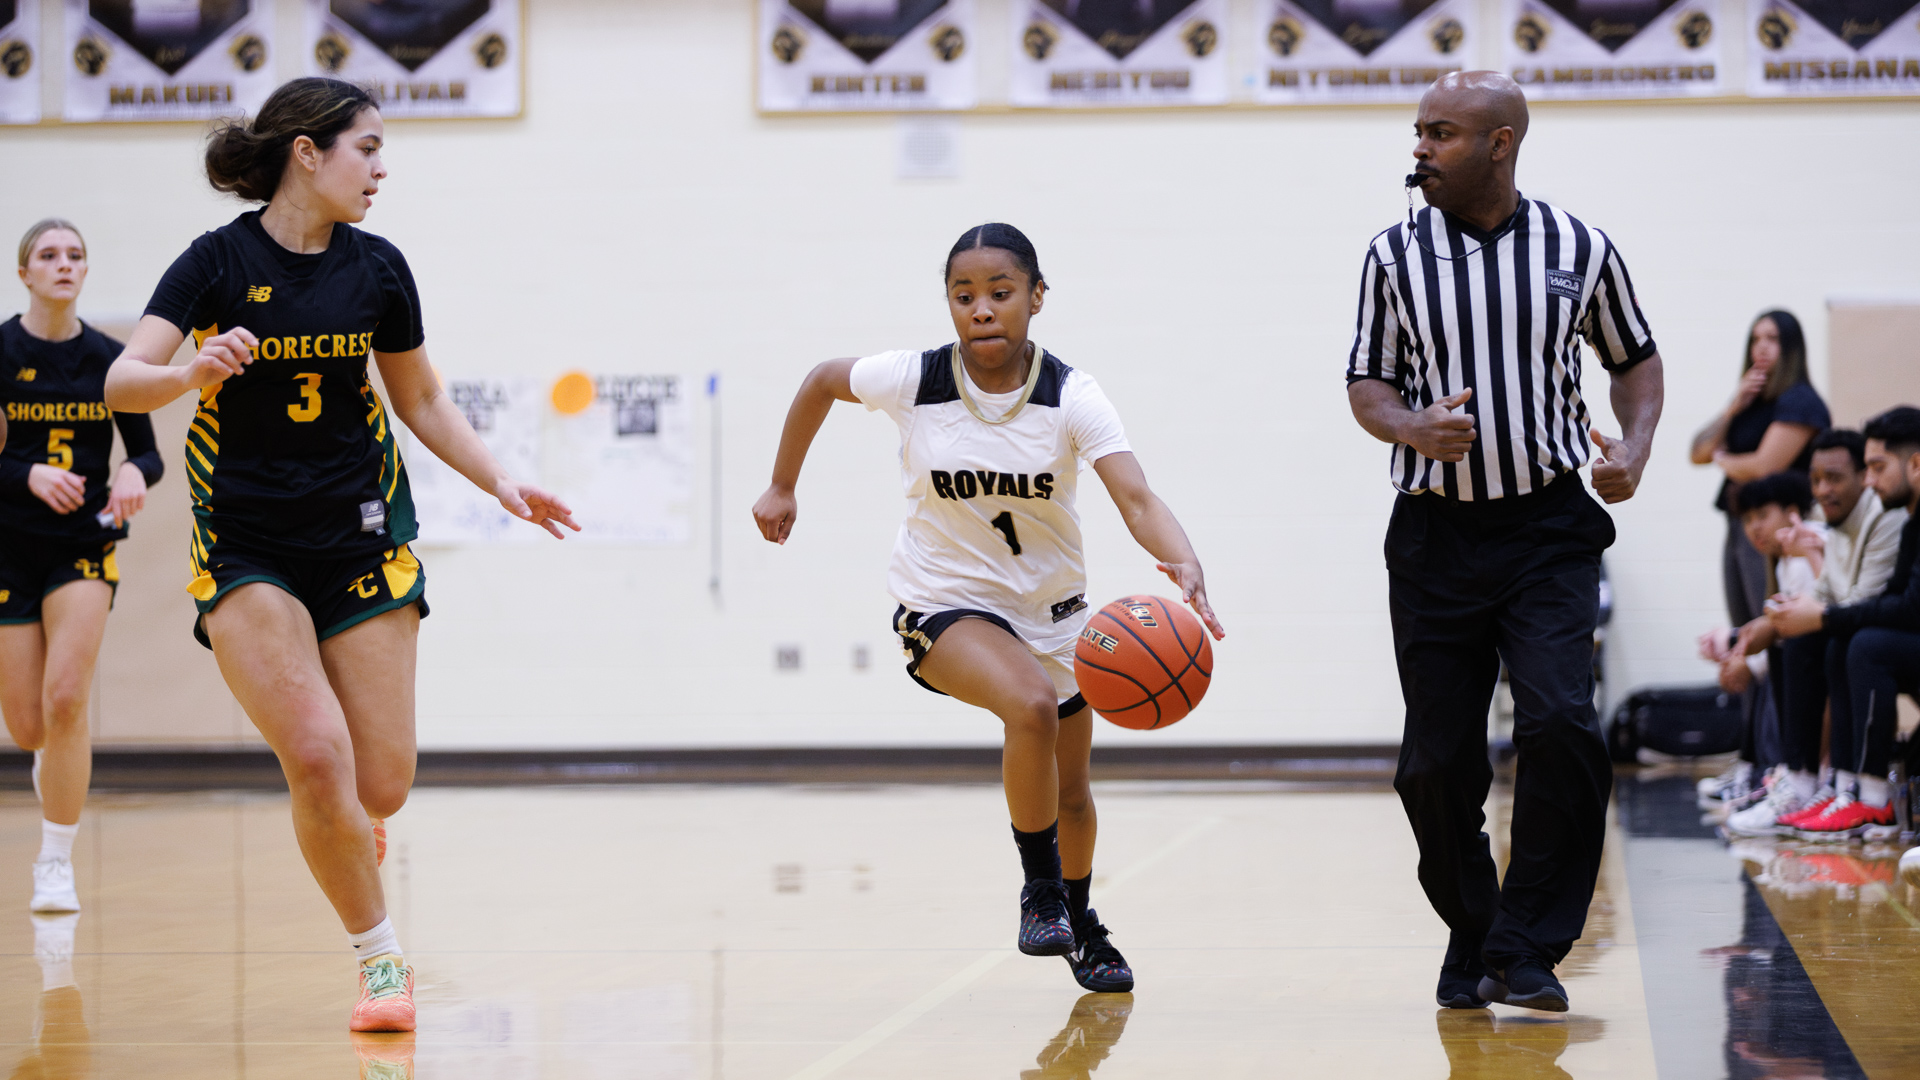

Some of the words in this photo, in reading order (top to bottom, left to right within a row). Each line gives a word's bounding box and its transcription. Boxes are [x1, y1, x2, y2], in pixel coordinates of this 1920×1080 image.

[244, 331, 373, 361] HORECREST
[287, 372, 323, 422] 3
[47, 428, 75, 471] 5
[930, 469, 1054, 501] ROYALS
[991, 511, 1022, 555] 1
[1081, 625, 1119, 654] LITE
